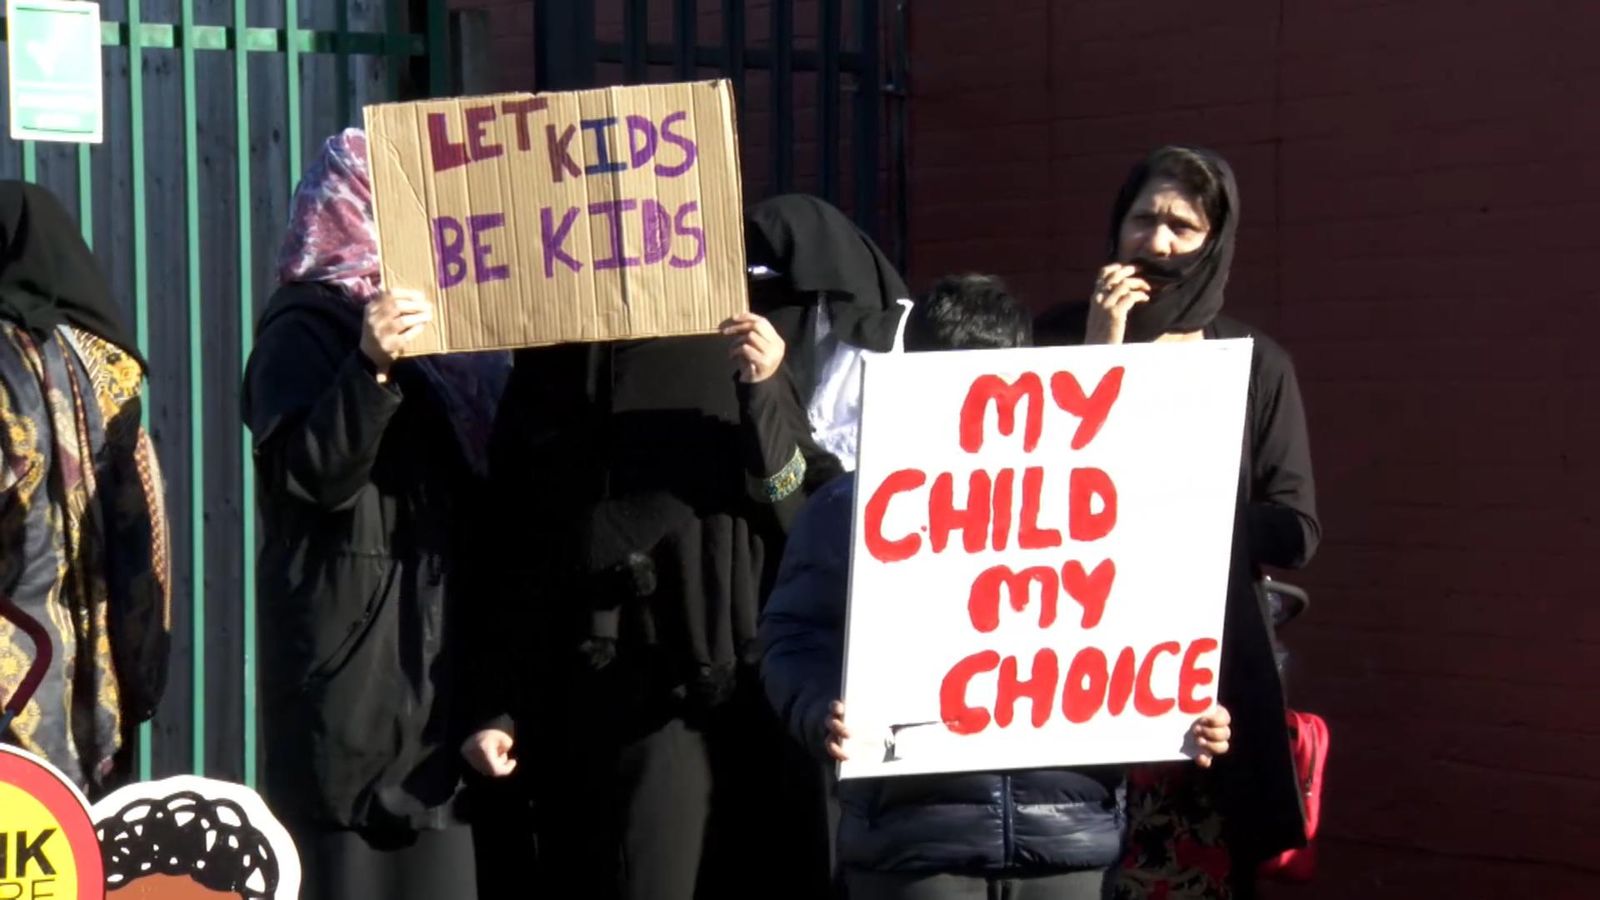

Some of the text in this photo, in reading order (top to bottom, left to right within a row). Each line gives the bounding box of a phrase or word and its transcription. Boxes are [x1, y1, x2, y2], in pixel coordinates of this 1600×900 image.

[426, 97, 698, 183] LET KIDS
[431, 198, 707, 289] BE KIDS
[959, 366, 1125, 453] MY
[864, 466, 1118, 563] CHILD
[968, 558, 1116, 633] MY
[939, 638, 1218, 735] CHOICE
[0, 828, 57, 878] K
